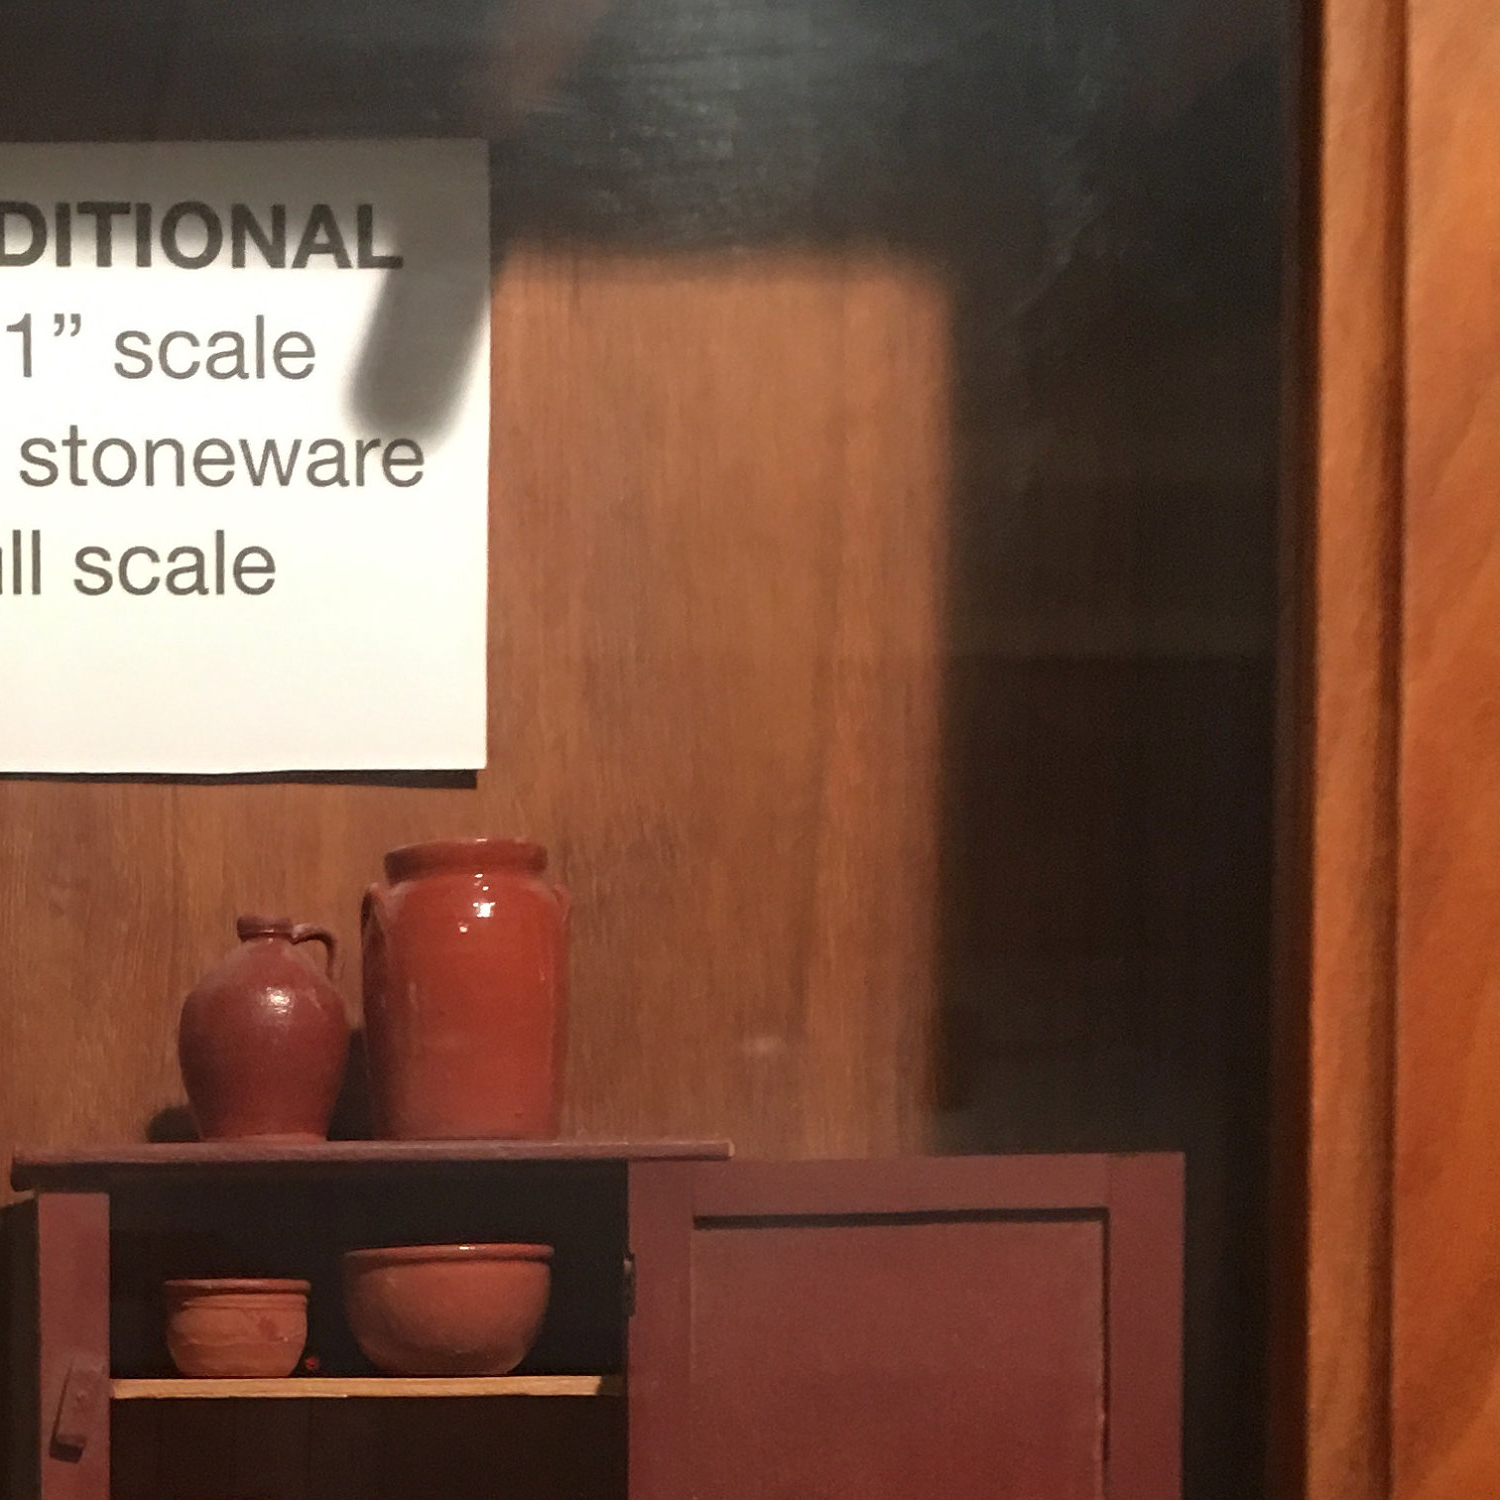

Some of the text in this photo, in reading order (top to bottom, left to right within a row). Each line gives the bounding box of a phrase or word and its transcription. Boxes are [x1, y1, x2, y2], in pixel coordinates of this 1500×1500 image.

[112, 314, 318, 382] scale
[18, 423, 426, 489] stoneware
[72, 528, 278, 598] scale
